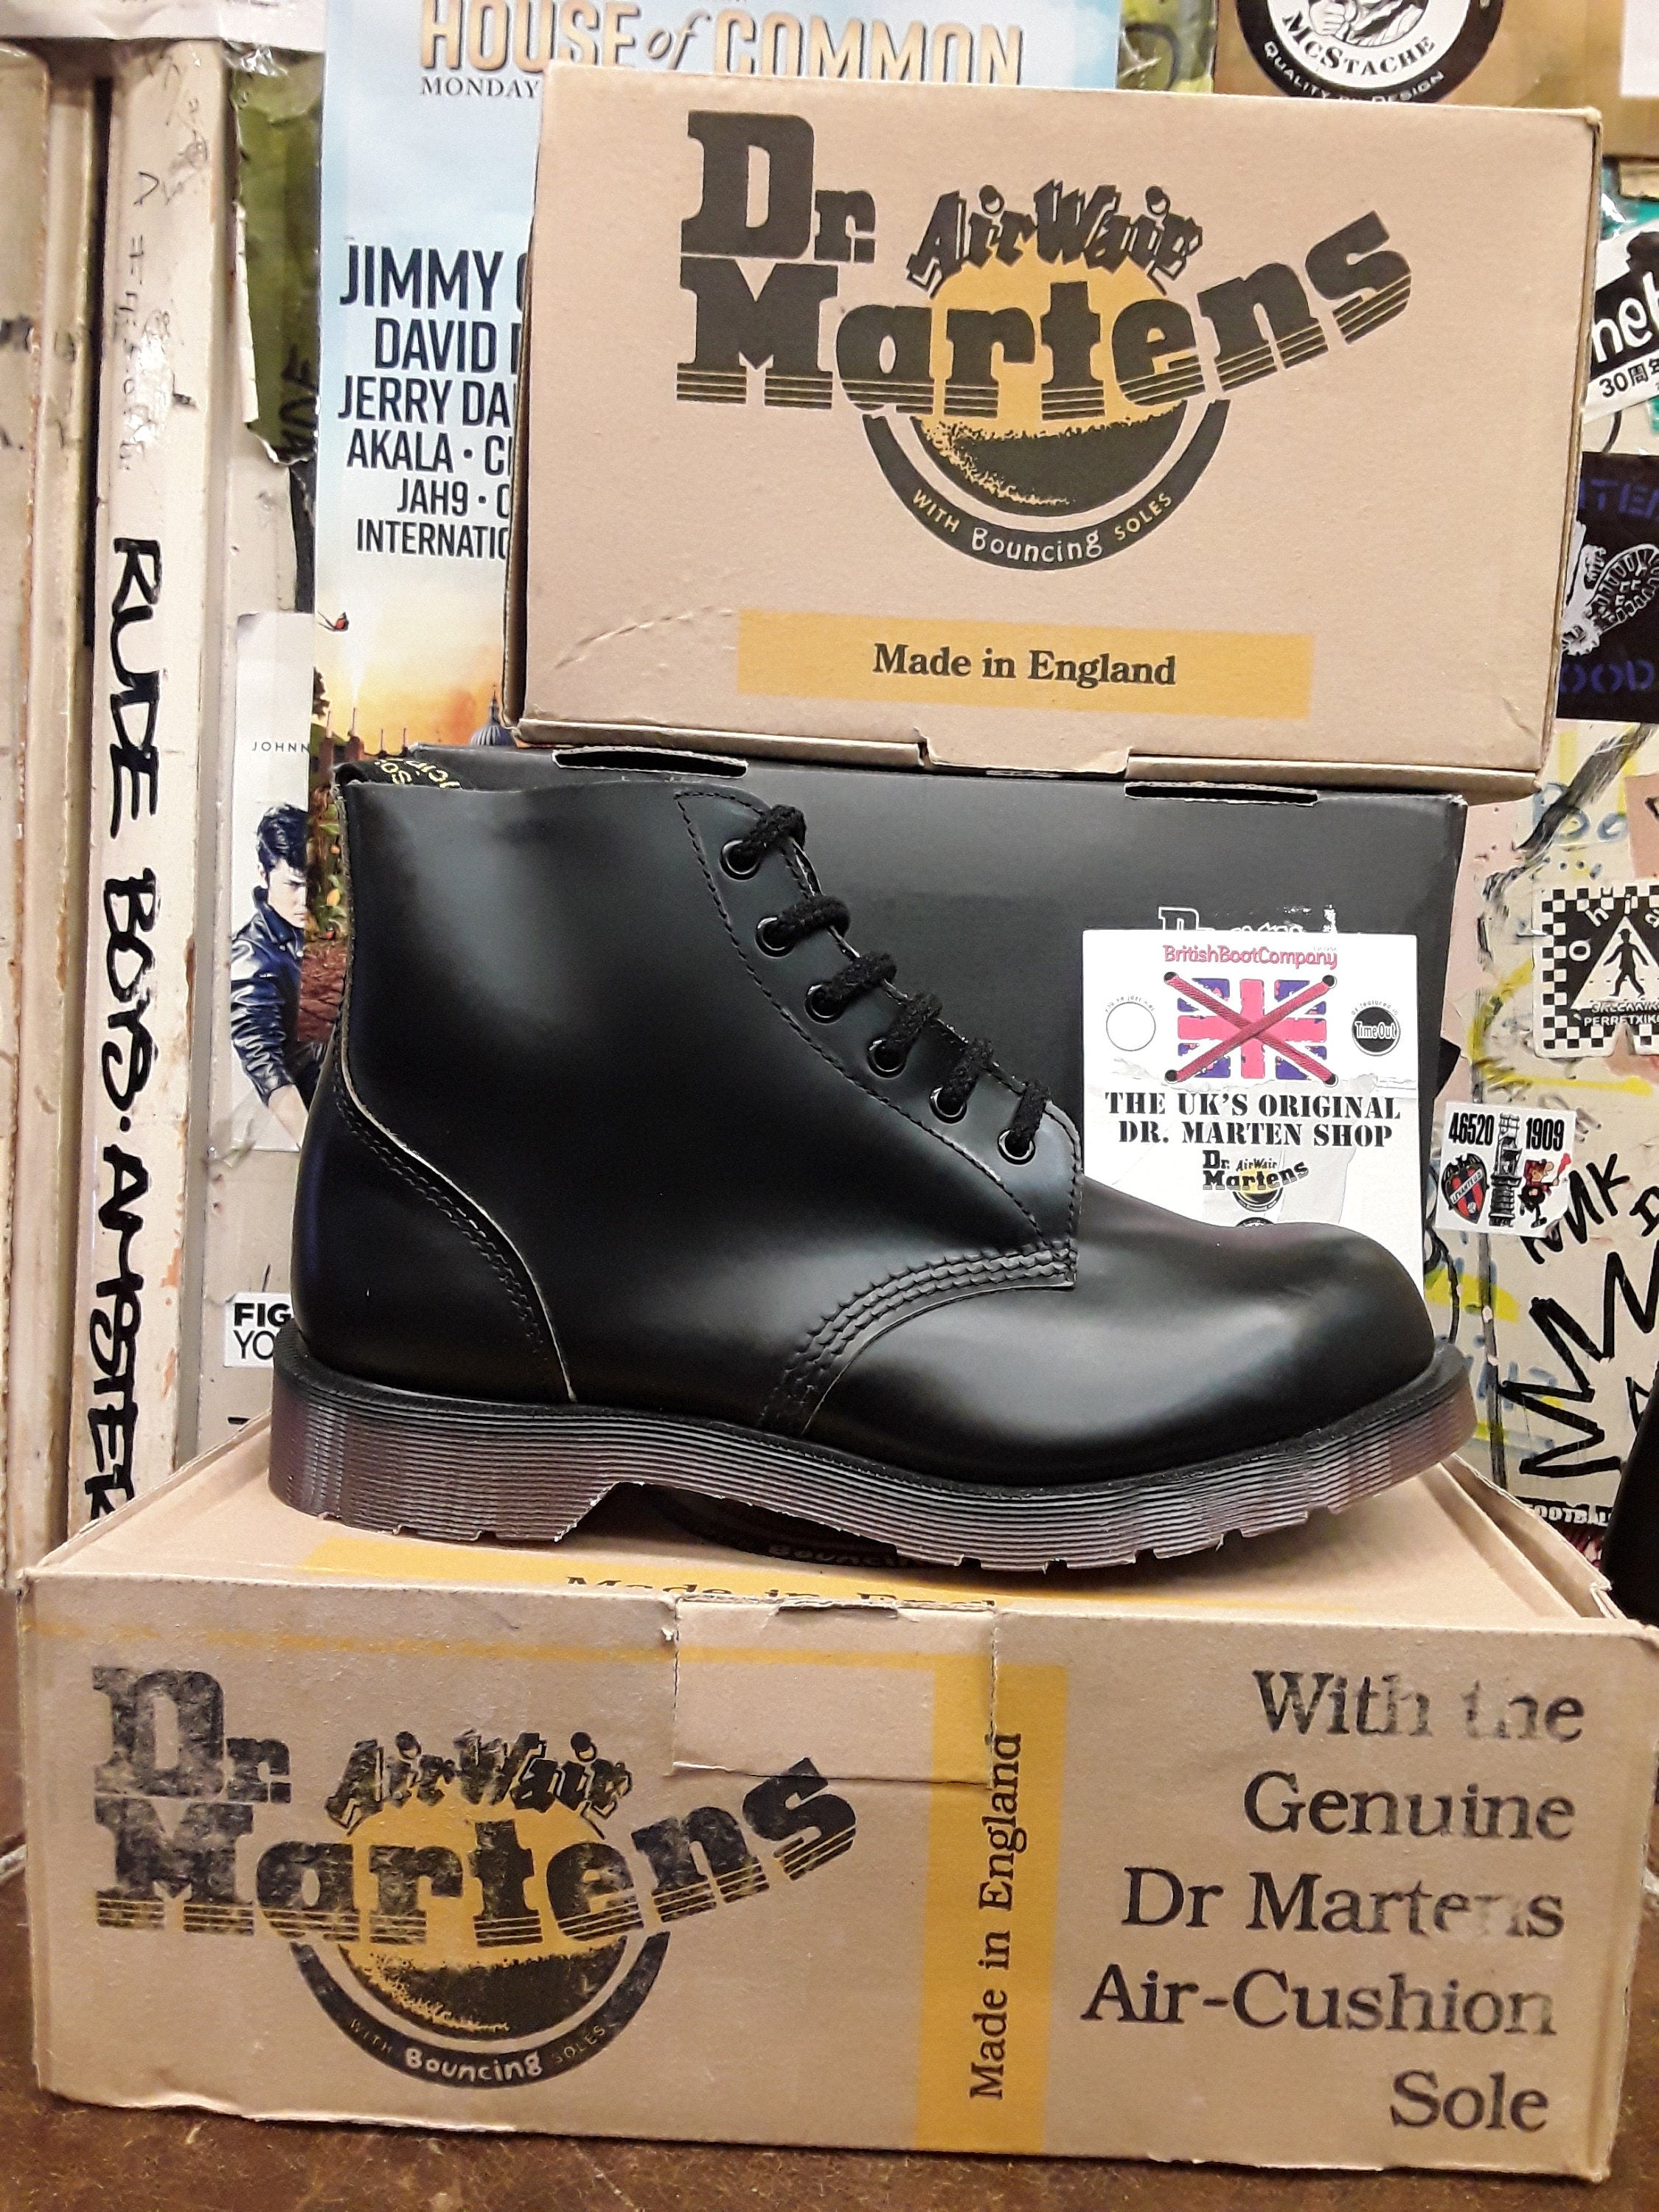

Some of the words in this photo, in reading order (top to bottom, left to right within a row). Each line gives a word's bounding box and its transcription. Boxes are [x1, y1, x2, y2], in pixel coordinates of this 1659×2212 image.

[419, 0, 640, 74] HOUSE
[647, 8, 713, 72] of
[714, 7, 1024, 86] COMMON
[420, 75, 539, 100] MONDAY
[339, 244, 504, 312] JIMMY
[675, 209, 1412, 421] Martens
[374, 317, 498, 372] DAVID
[338, 375, 450, 423] JERRY
[462, 380, 517, 428] DA
[347, 428, 453, 473] AKALA
[397, 478, 469, 517] JAH9
[912, 489, 961, 534] WITH
[971, 527, 1104, 563] Bouncing
[1113, 492, 1173, 541] SOLES
[110, 537, 162, 839] RUDE
[872, 643, 972, 677] Made
[981, 647, 1017, 680] in
[1027, 650, 1177, 689] England
[1105, 1092, 1166, 1115] THE
[1178, 1093, 1248, 1117] UK'S
[1258, 1094, 1401, 1120] ORIGINAL
[1448, 1112, 1495, 1146] 46520
[1525, 1117, 1565, 1152] 1909
[1118, 1121, 1169, 1144] DR.
[1181, 1122, 1301, 1147] MARTEN
[1313, 1124, 1393, 1147] SHOP
[1202, 1161, 1310, 1190] Martens
[234, 1302, 292, 1327] FIG
[233, 1329, 275, 1360] YO
[1527, 1503, 1613, 1527] OOTBAL
[1251, 1669, 1433, 1738] With
[978, 1732, 1028, 1912] England
[1243, 1770, 1576, 1841] Genuine
[93, 1756, 858, 1948] Martens
[1121, 1865, 1224, 1929] Dr
[1245, 1871, 1566, 1938] Martens
[978, 1929, 1011, 1970] in
[1080, 1962, 1558, 2036] Air-Cushion
[404, 2046, 544, 2083] Bouncing
[969, 1988, 1008, 2101] Made
[1390, 2067, 1548, 2132] Sole
